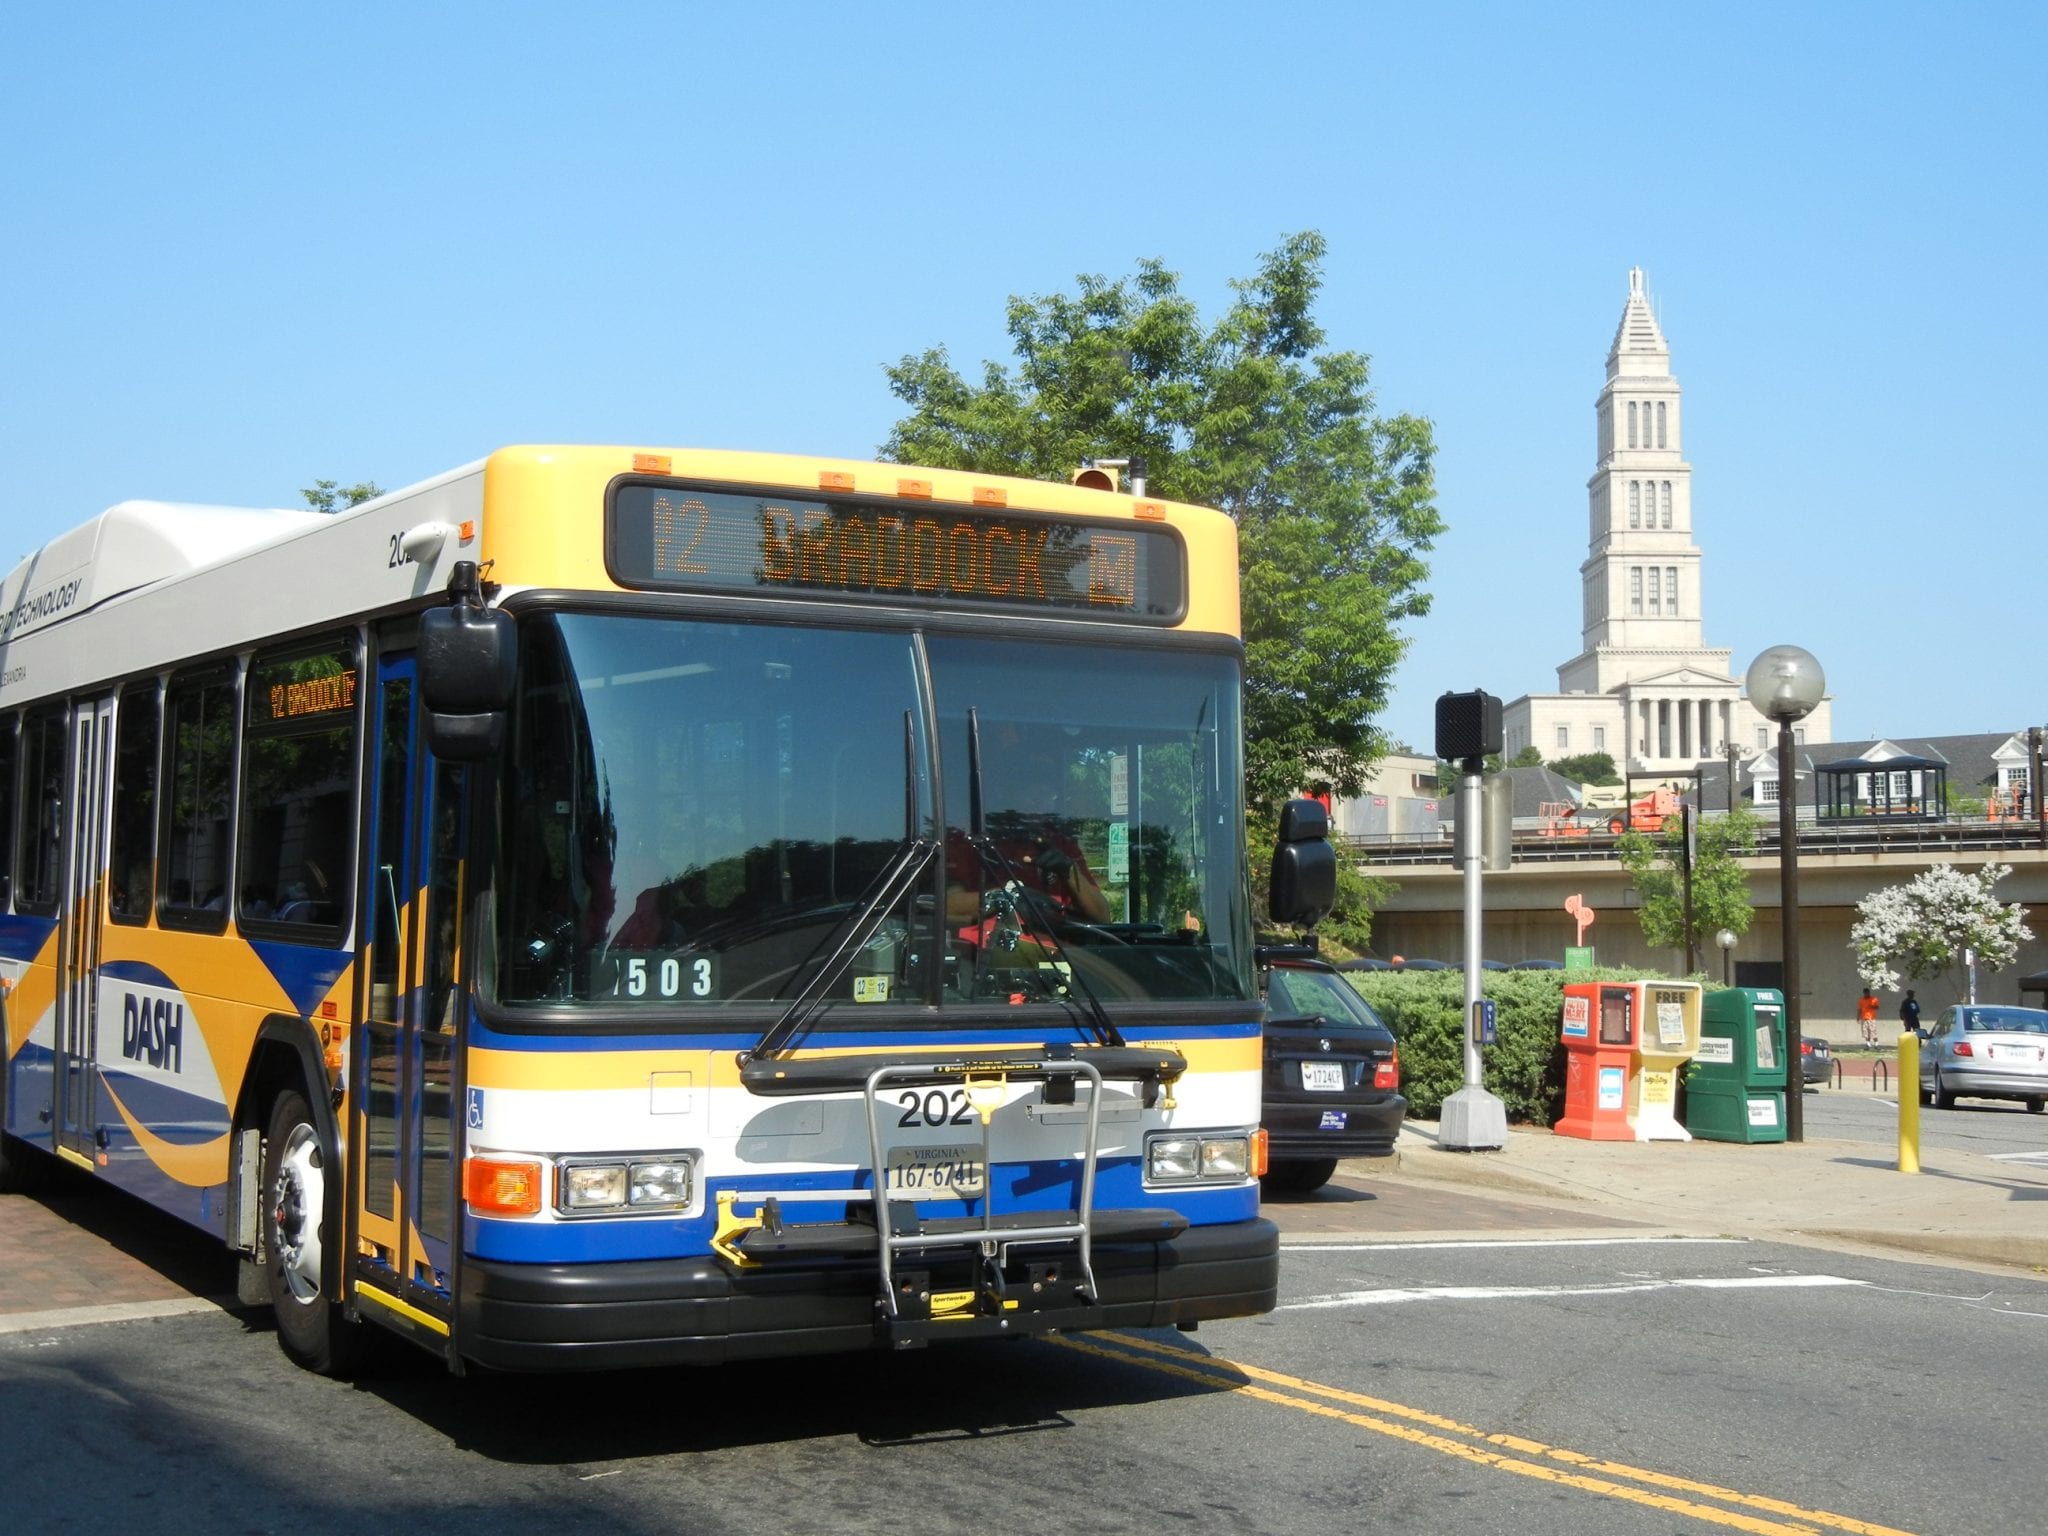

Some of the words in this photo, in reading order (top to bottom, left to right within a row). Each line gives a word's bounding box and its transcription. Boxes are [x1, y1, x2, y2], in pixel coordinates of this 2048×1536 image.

[389, 531, 415, 568] 20
[763, 505, 1049, 599] BRADDOCK
[15, 578, 82, 628] TECHNOLOGY
[287, 676, 342, 716] BRADDOCK
[613, 958, 712, 996] 503
[1756, 992, 1775, 1000] FREE
[1566, 1008, 1586, 1019] MART
[1656, 991, 1686, 1004] FREE
[123, 992, 183, 1075] DASH
[898, 1090, 973, 1128] 202
[914, 1148, 960, 1159] VIRGINIA
